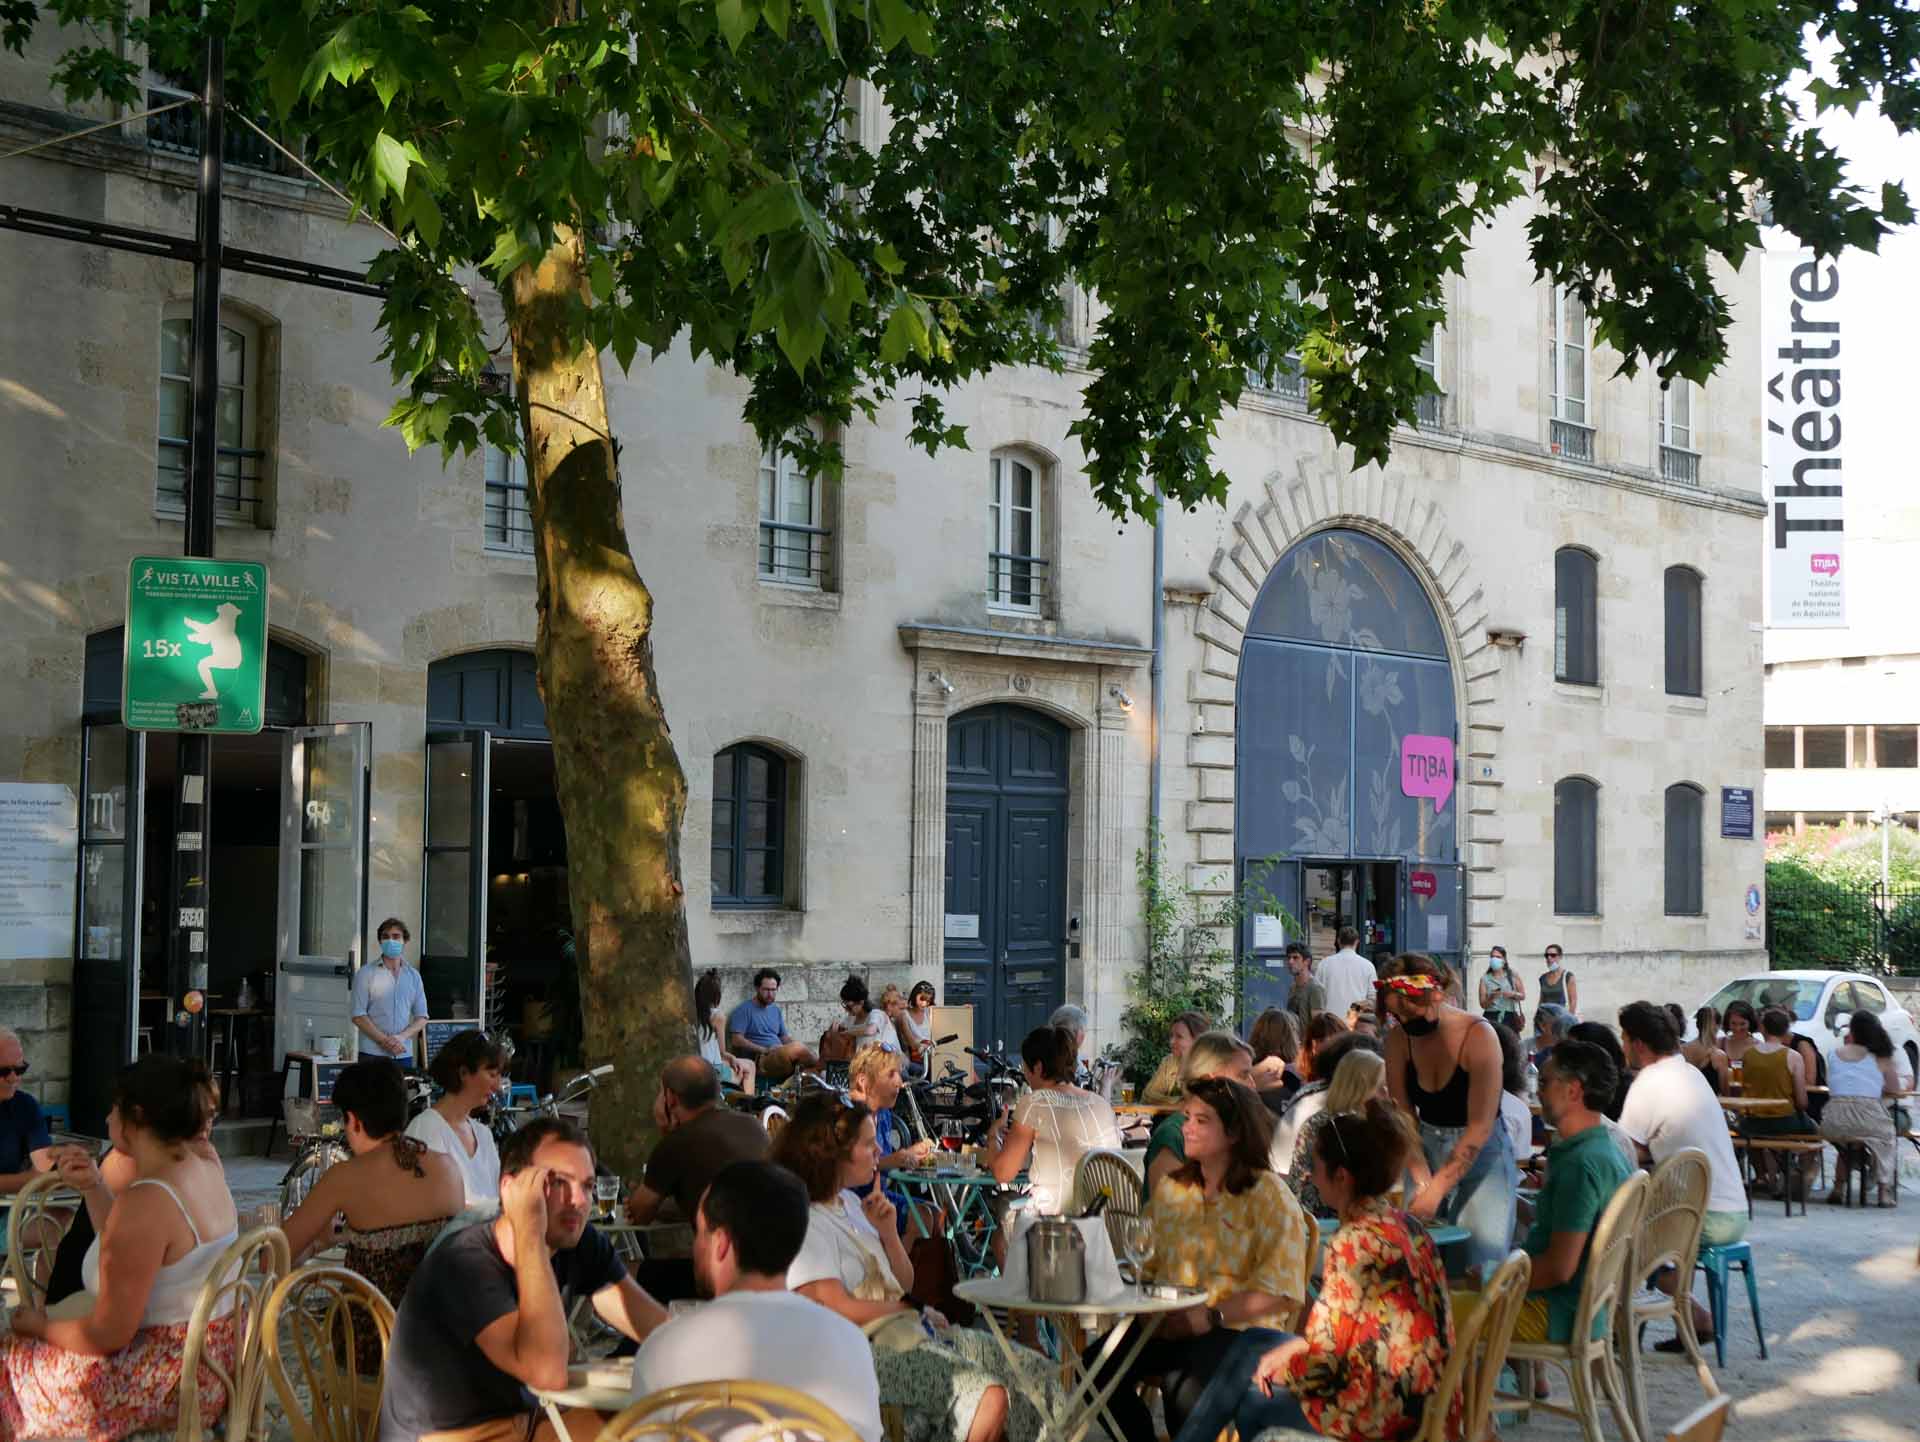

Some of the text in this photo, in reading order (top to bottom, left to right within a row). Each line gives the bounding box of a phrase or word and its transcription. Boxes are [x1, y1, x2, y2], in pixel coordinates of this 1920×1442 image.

[1767, 261, 1844, 549] Théâtre
[157, 572, 241, 588] VIS TA VILLE
[143, 639, 182, 657] 15x
